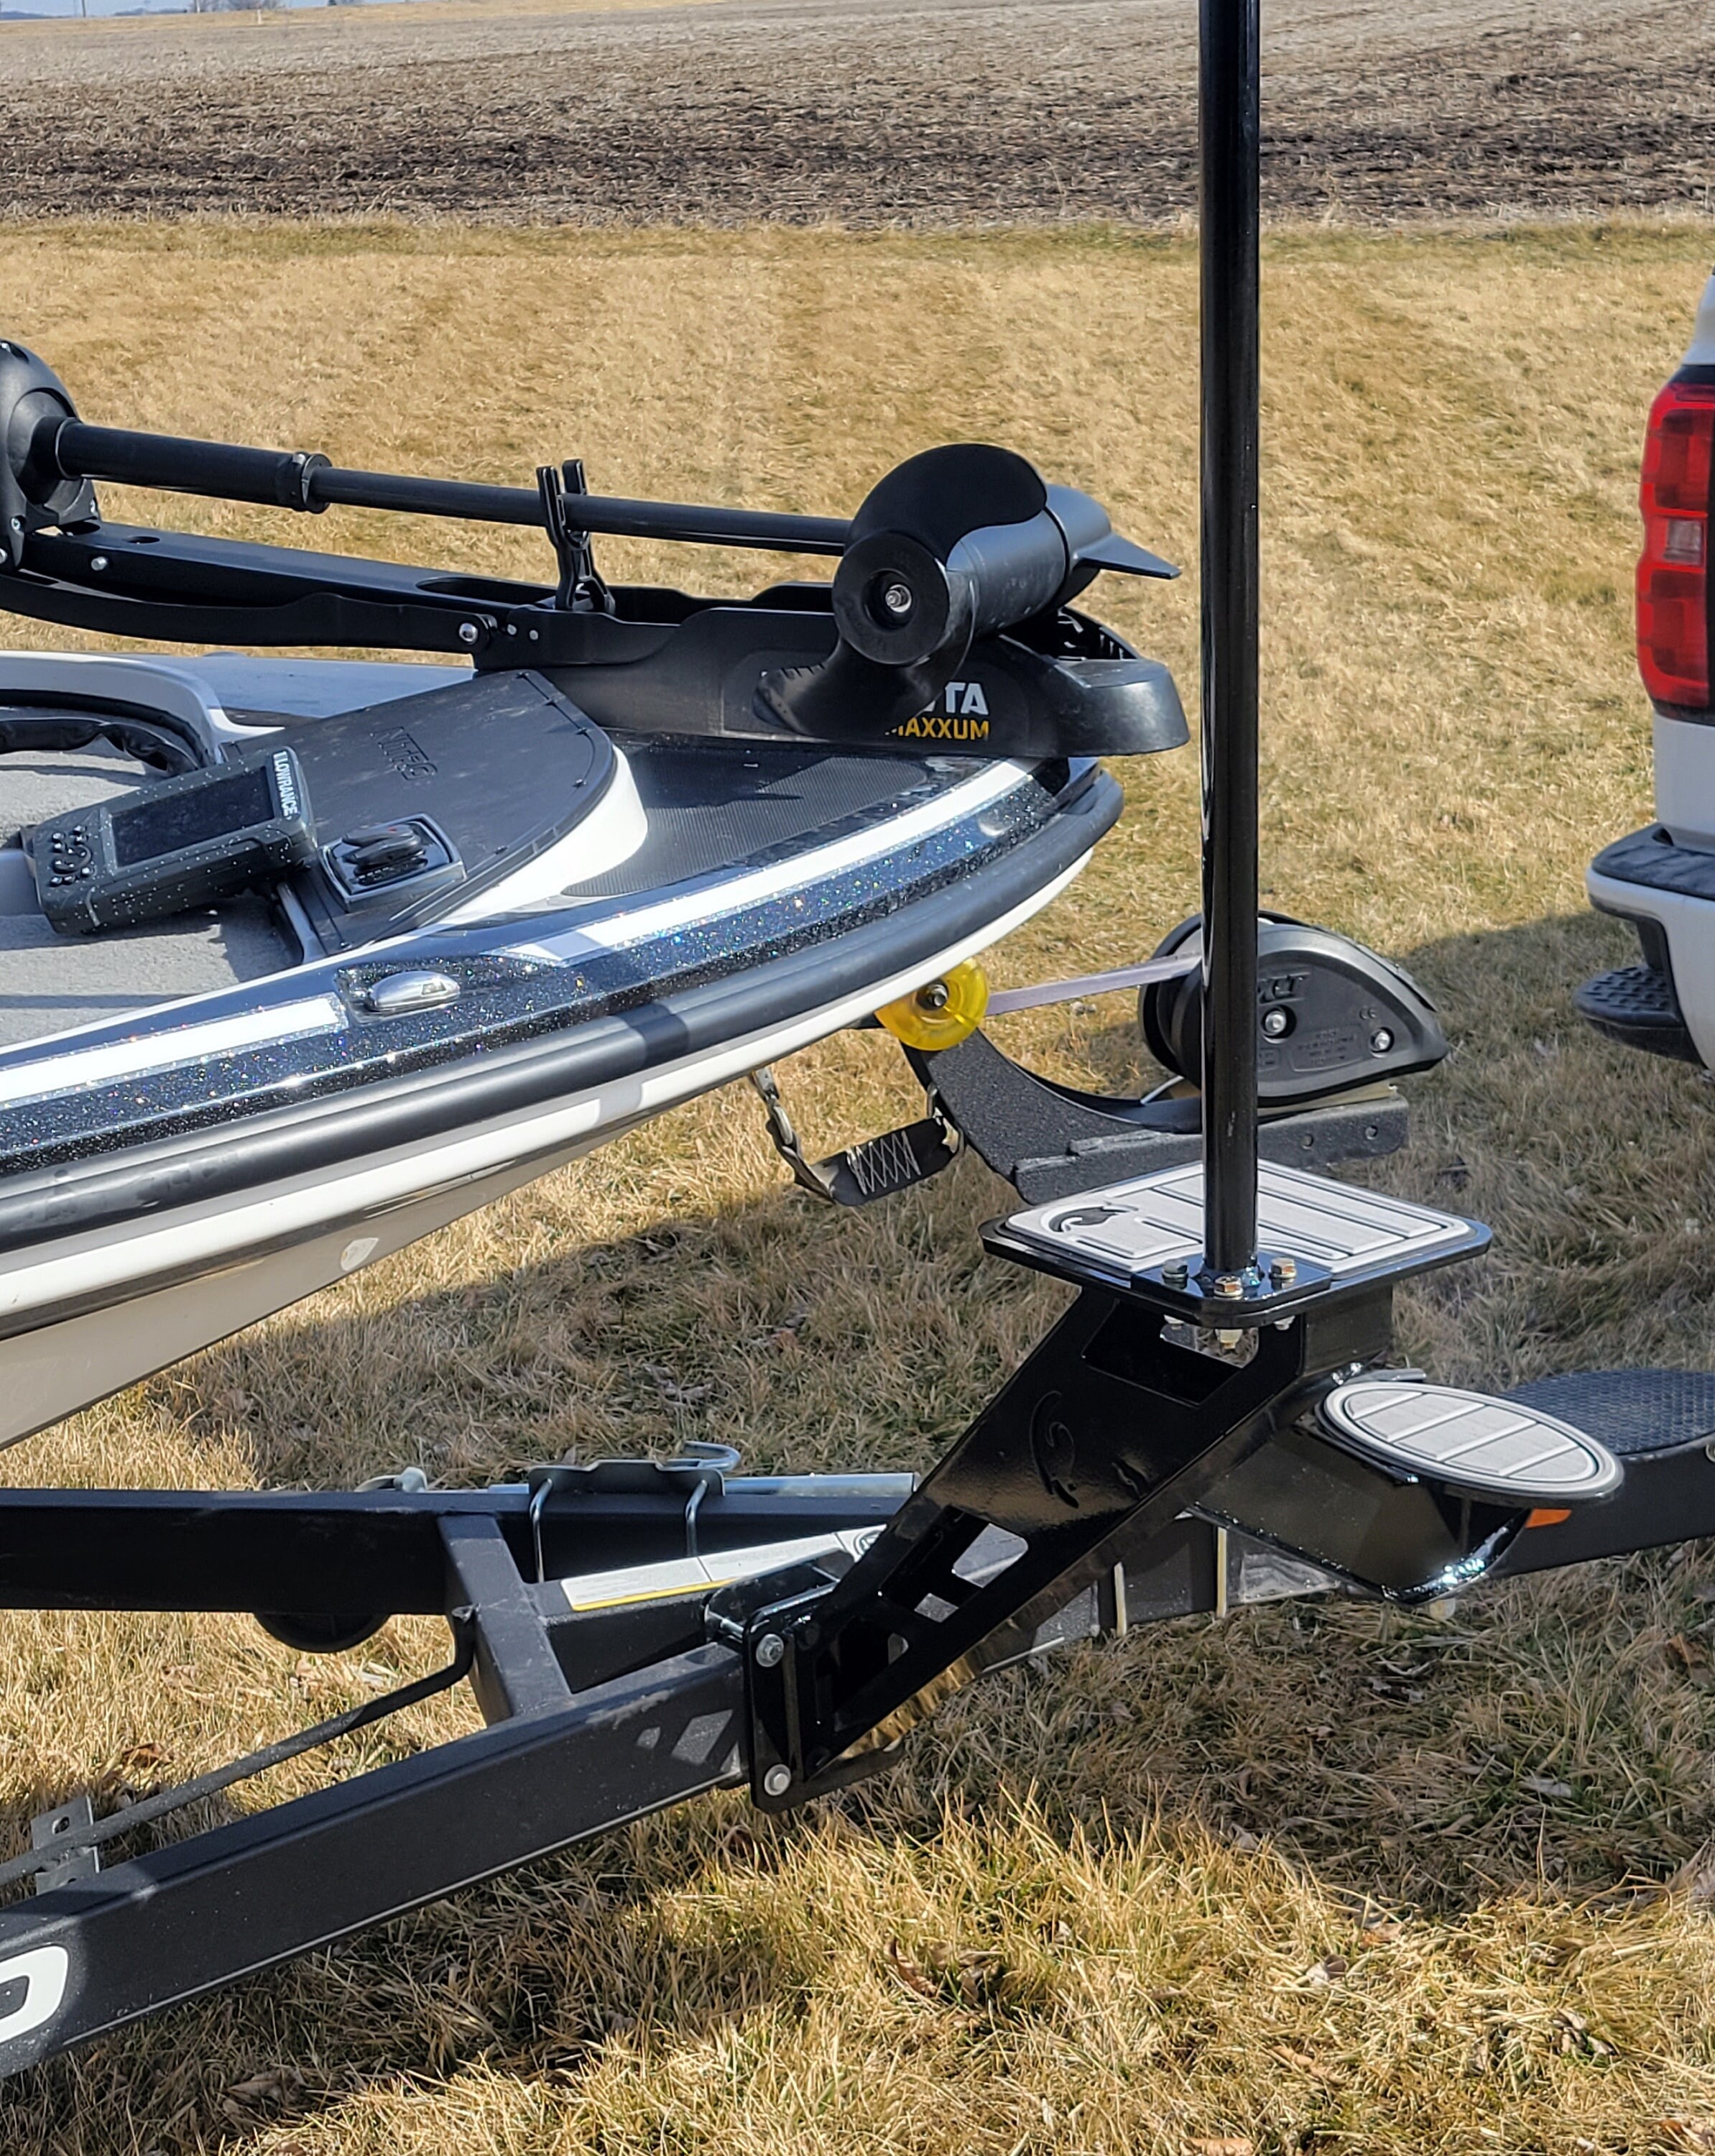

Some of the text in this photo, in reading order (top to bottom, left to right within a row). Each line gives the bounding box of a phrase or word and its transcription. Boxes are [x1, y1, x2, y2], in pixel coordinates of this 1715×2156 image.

[925, 681, 989, 715] TA
[885, 717, 989, 741] AXXUM
[274, 756, 298, 817] LOWRANCE
